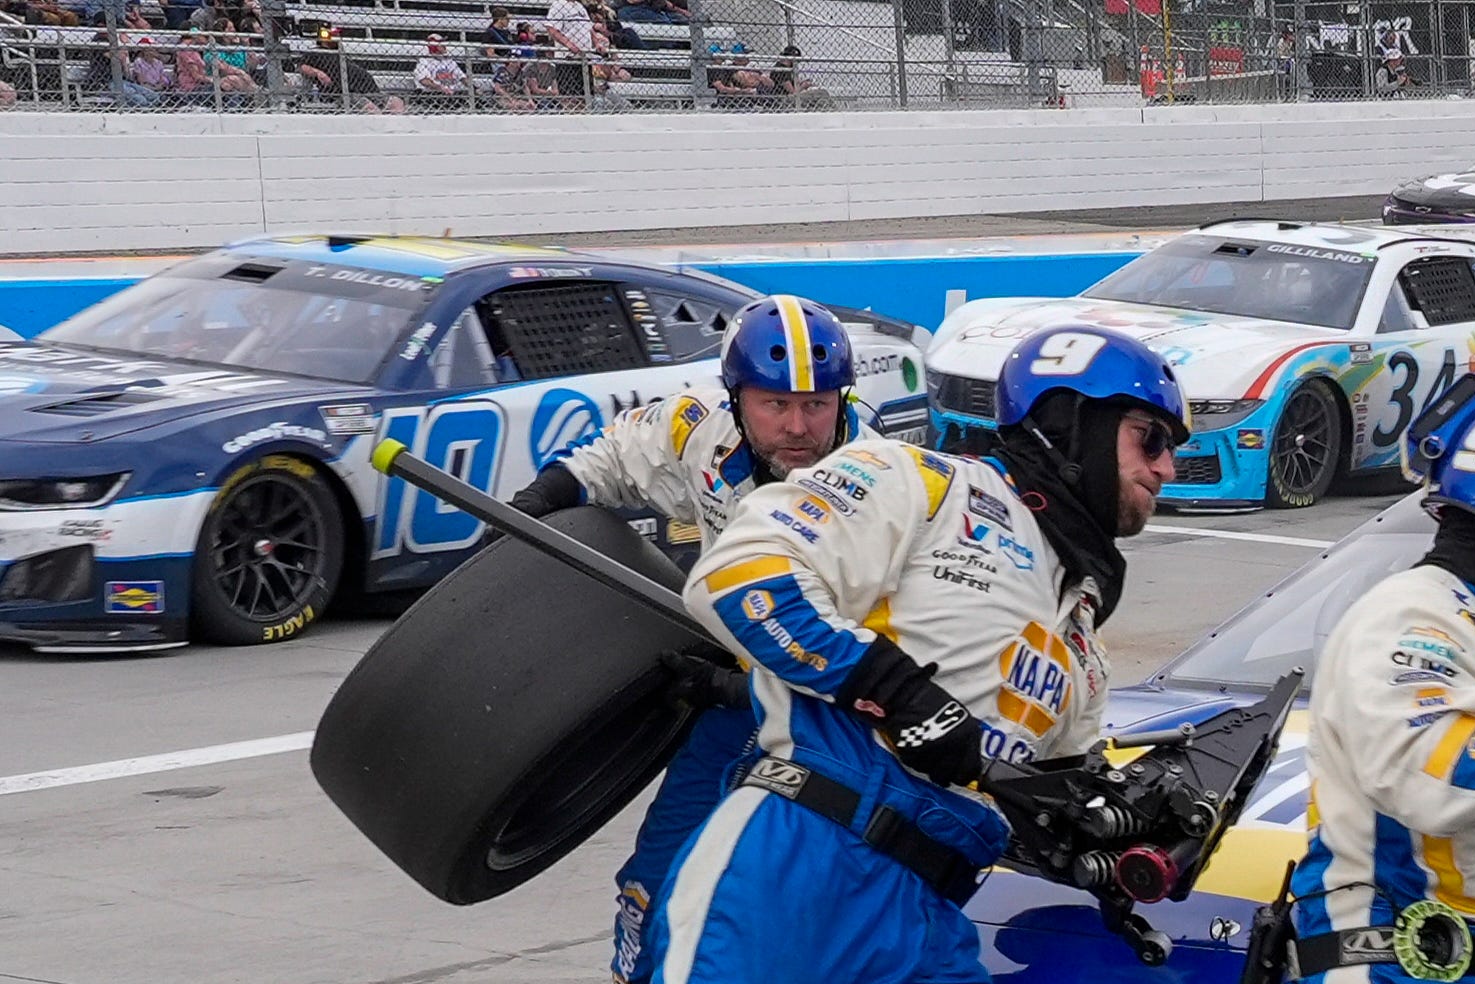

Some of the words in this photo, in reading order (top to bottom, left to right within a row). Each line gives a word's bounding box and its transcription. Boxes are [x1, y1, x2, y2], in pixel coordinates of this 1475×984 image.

[1267, 243, 1363, 265] GILLILAND
[304, 266, 325, 277] T.
[331, 270, 422, 292] DILLON
[1030, 332, 1108, 377] 9
[372, 400, 507, 559] 10
[812, 469, 869, 502] CLIMB
[769, 509, 795, 531] AUTO
[792, 520, 821, 545] CARE
[797, 500, 825, 522] NAPA
[932, 549, 998, 574] GOODYEAR
[933, 565, 992, 593] UniFirst
[263, 604, 314, 641] EAGLE
[762, 617, 793, 649] AUTO
[1007, 643, 1065, 716] NAPA
